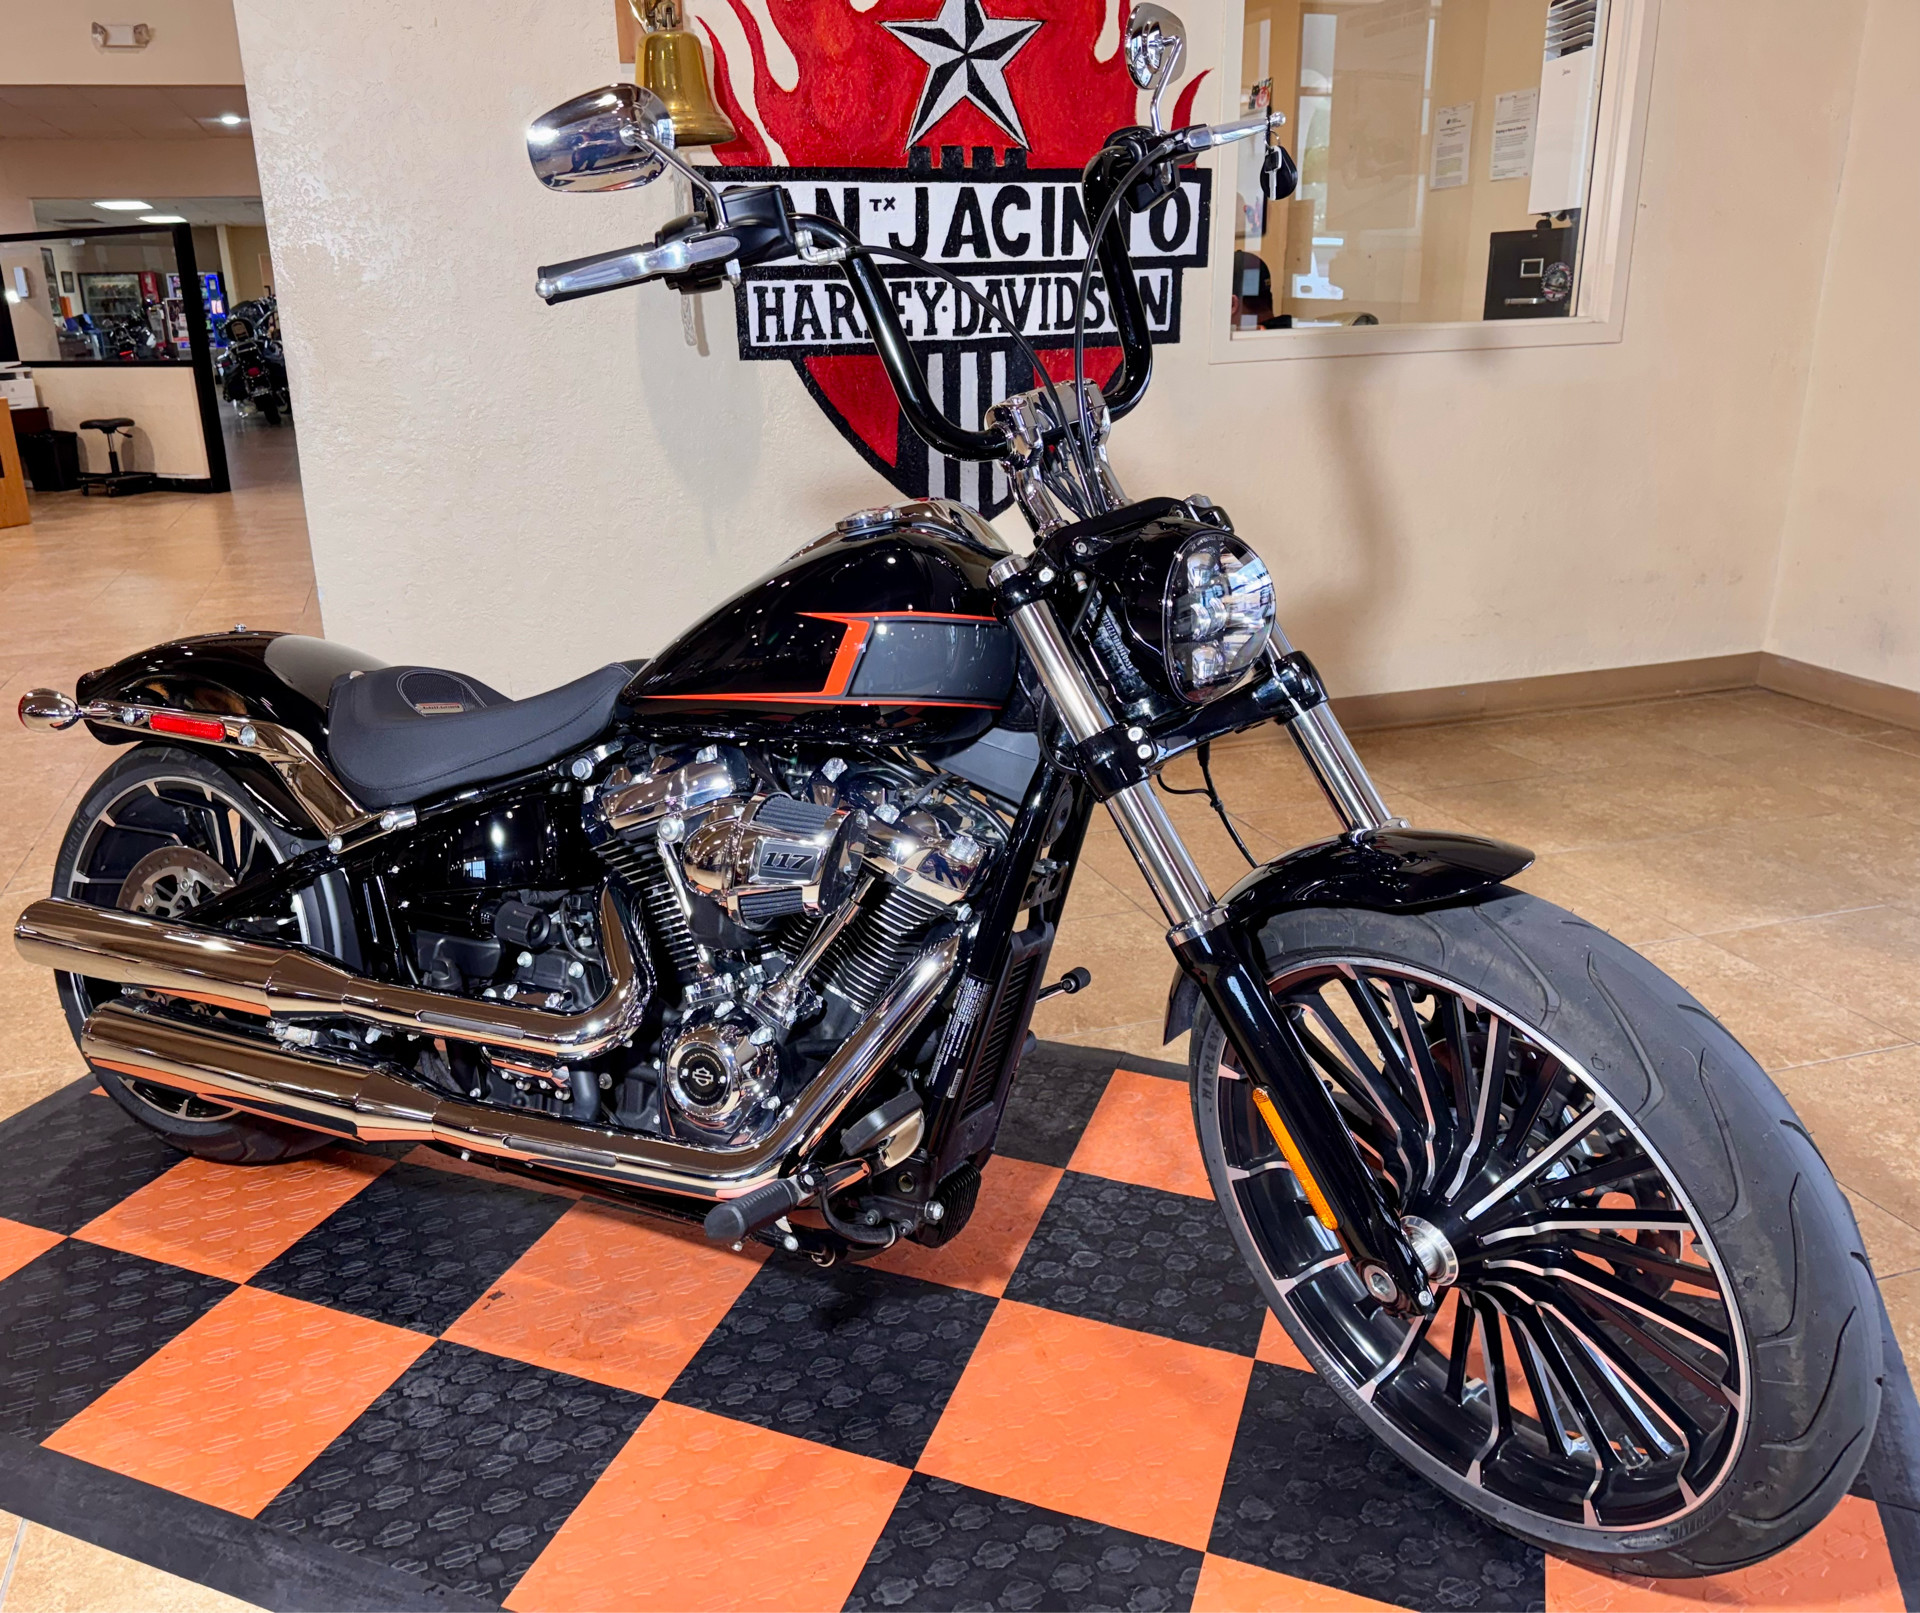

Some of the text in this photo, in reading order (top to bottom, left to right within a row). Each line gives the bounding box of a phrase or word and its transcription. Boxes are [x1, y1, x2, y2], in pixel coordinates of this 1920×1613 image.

[869, 196, 896, 212] TX
[761, 851, 815, 871] 117
[1201, 1020, 1220, 1101] HARLEY-
